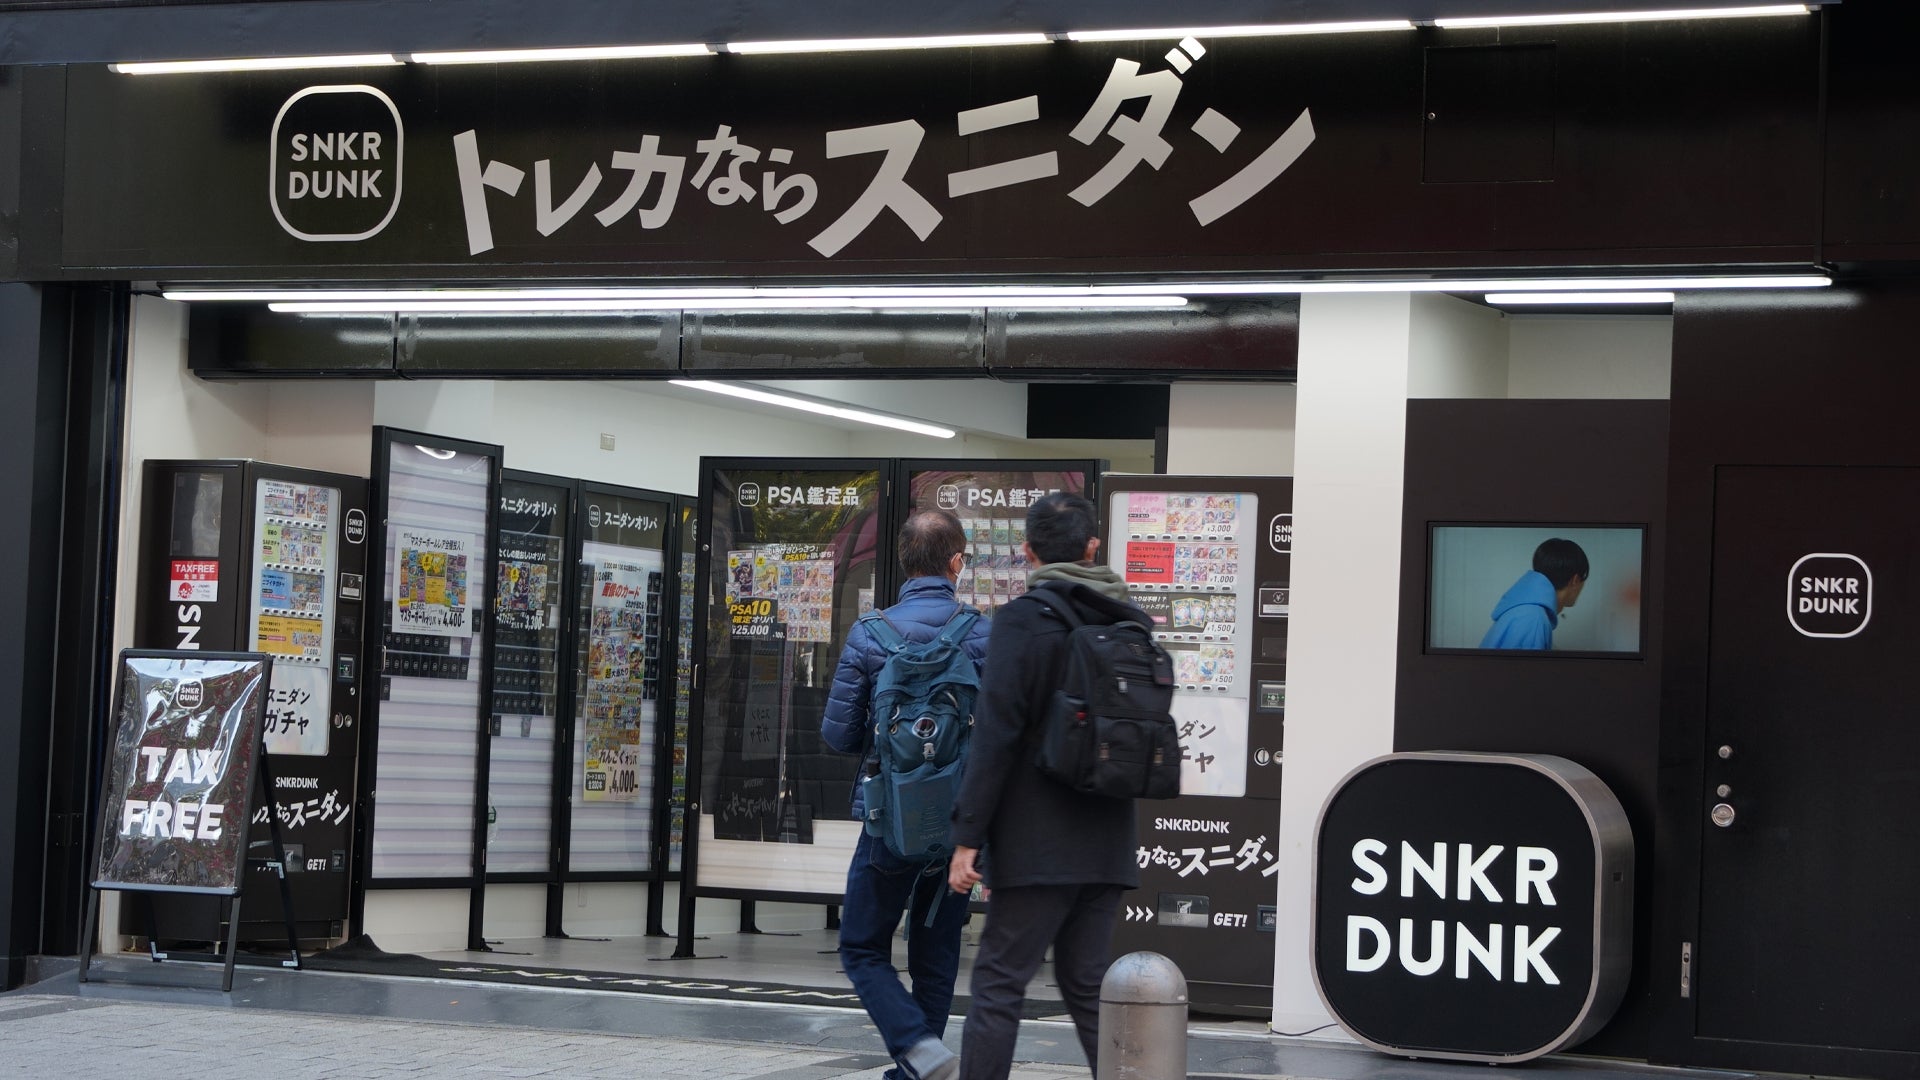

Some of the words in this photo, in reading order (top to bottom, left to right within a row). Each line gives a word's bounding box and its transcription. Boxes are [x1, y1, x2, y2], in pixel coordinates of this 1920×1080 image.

[291, 132, 382, 161] SNKR
[453, 36, 1316, 257] トレカならスニダン
[289, 169, 383, 199] DUNK
[501, 497, 557, 518] スニダンオリパ
[349, 518, 363, 527] SNKR
[604, 512, 658, 531] スニダンオリパ
[348, 526, 363, 535] DUNK
[175, 564, 215, 573] TAXFREE
[602, 582, 641, 599] 画像のカード
[1801, 577, 1859, 594] SNKR
[729, 600, 771, 615] PSA10
[1799, 597, 1860, 615] DUNK
[732, 615, 775, 624] 確定オリパ
[1215, 675, 1233, 683] ¥500
[180, 694, 200, 702] DUNK
[264, 707, 310, 735] ガチャ
[141, 746, 223, 785] TAX
[275, 777, 318, 789] SNKRDUNK
[121, 800, 225, 841] FREE
[1155, 817, 1230, 834] SNKRDUNK
[307, 858, 326, 871] GET!
[1351, 838, 1559, 905] SNKR
[1213, 912, 1248, 927] GET!
[1346, 914, 1562, 985] DUNK
